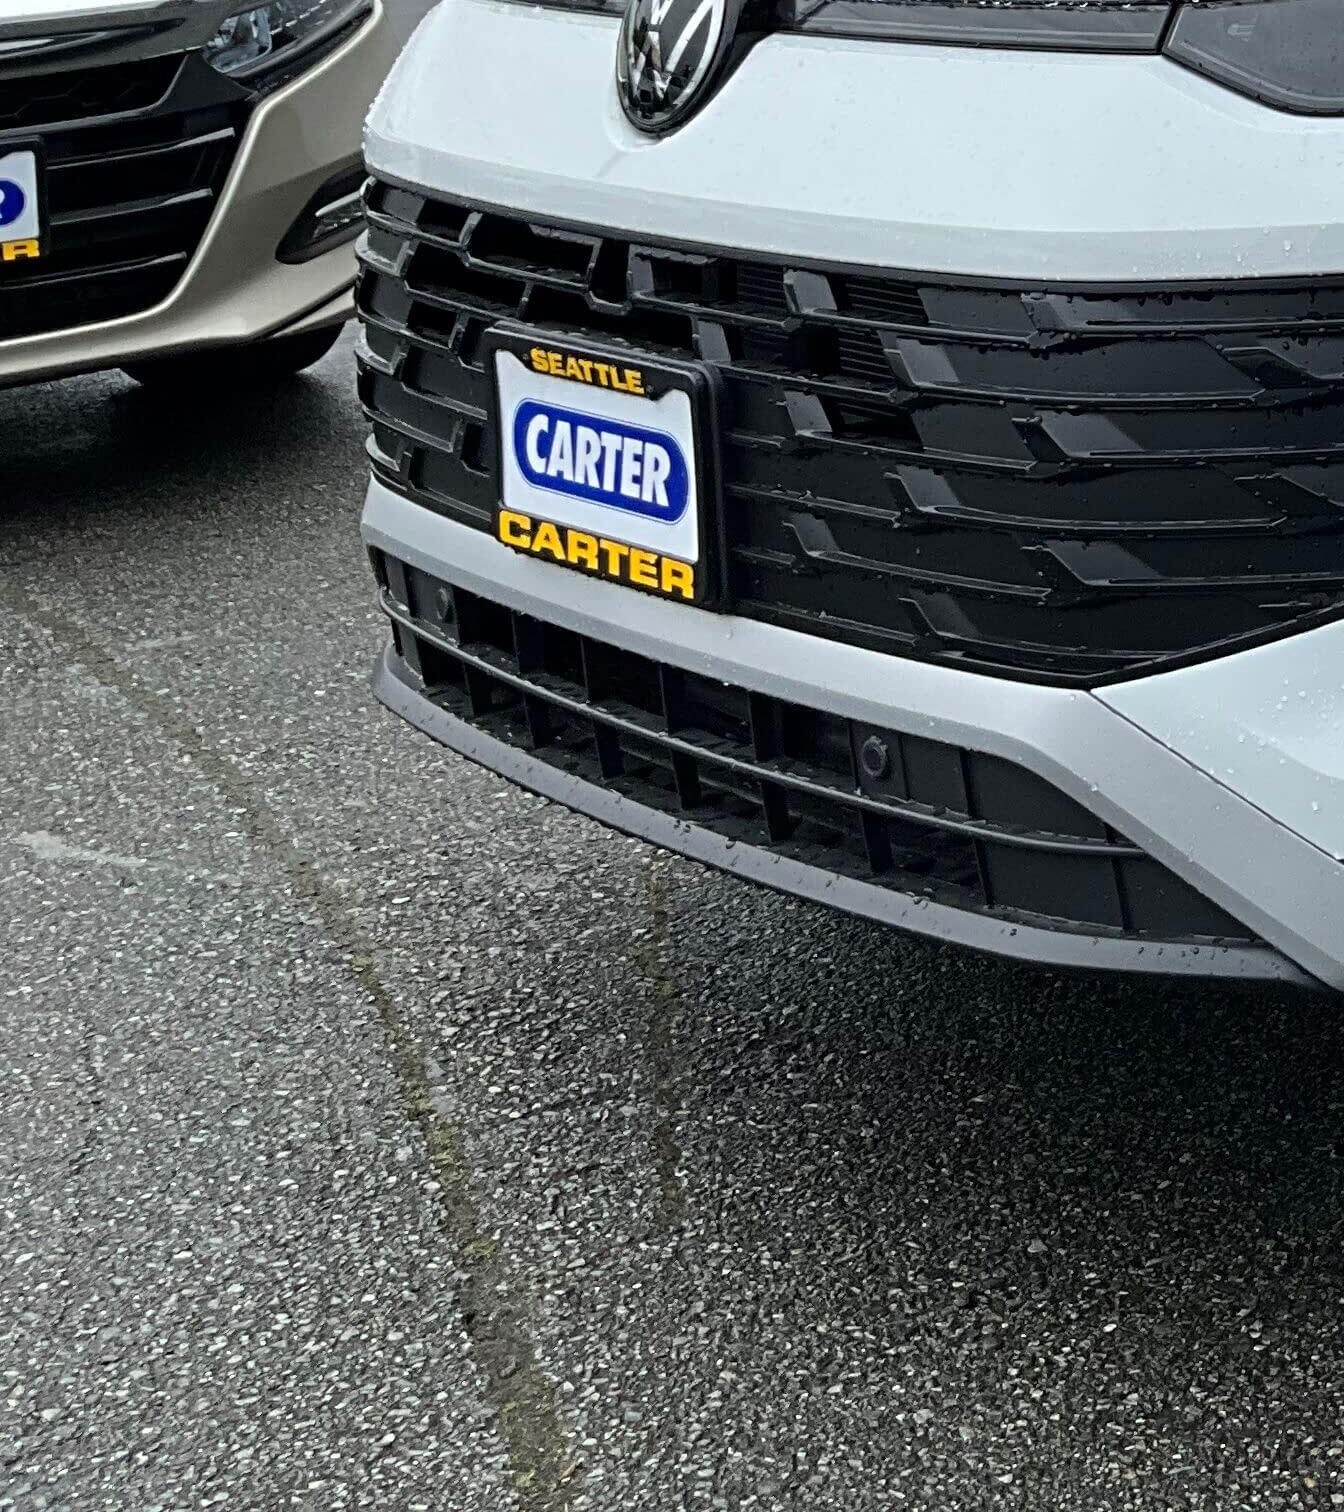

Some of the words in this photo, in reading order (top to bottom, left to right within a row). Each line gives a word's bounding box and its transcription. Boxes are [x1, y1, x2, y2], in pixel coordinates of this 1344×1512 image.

[530, 347, 644, 395] SEATTLE
[525, 413, 671, 507] CARTER
[499, 509, 694, 599] CARTER
